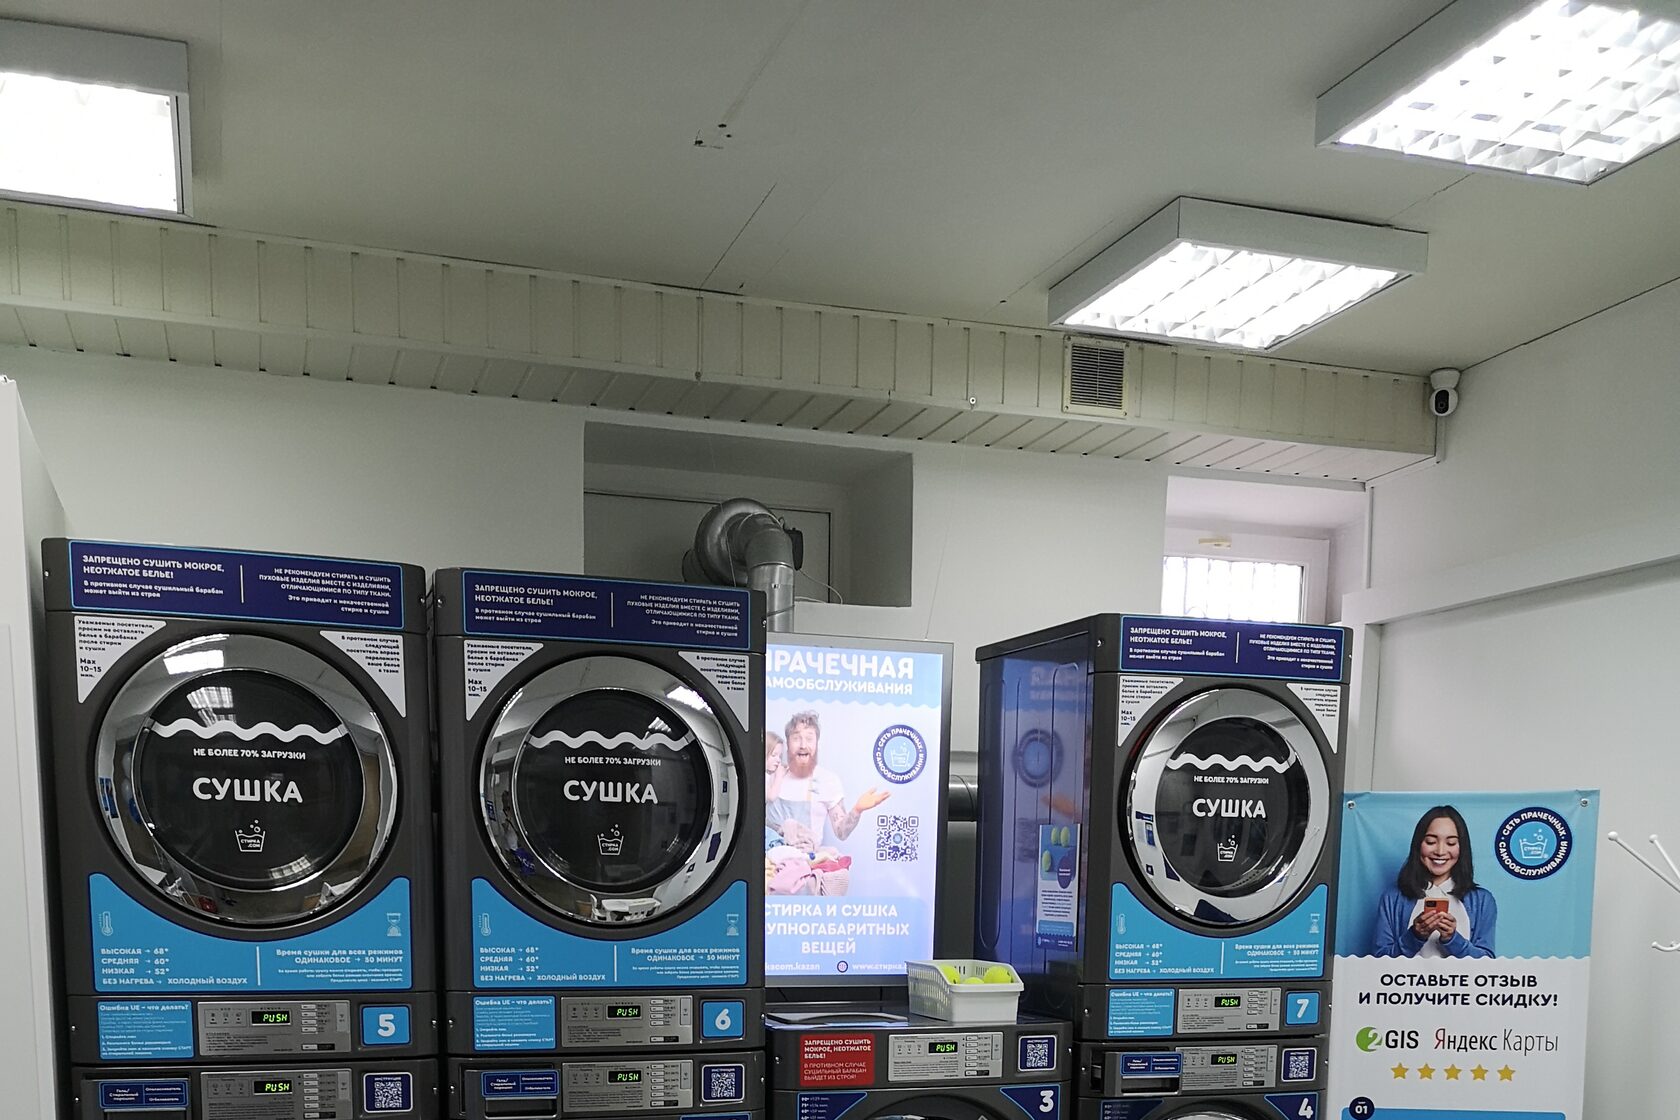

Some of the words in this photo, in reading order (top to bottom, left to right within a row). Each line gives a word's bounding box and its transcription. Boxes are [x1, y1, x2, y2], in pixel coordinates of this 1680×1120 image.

[83, 555, 140, 566] ЗАПРЕЩЕНО
[143, 559, 182, 568] СУШИТЬ
[184, 562, 224, 572] МОКРОЕ,
[84, 566, 140, 577] НЕОТЖАТОЕ
[143, 569, 173, 578] БЕЛЬЕ!
[475, 585, 524, 594] ЗАПРЕЩЕНО
[527, 588, 561, 596] СУШИТЬ
[563, 590, 597, 599] МОКРОЕ,
[475, 595, 524, 604] НЕОТЖАТОЕ
[527, 597, 553, 605] БЕЛЬЕ!
[766, 677, 912, 695] АМООБСЛУЖИВАНИЯ
[194, 748, 206, 757] НЕ
[208, 749, 238, 757] БОЛЕЕ
[241, 750, 259, 758] 70%
[261, 750, 306, 760] ЗАГРУЗКИ
[623, 758, 661, 766] ЗАГРУЗКИ
[193, 777, 303, 803] СУШКА
[563, 780, 658, 804] СУШКА
[1192, 798, 1266, 818] СУШКА
[1502, 816, 1521, 837] СЕТЬ
[1520, 810, 1566, 838] ПРАЧЕЧНЫХ
[1498, 840, 1569, 877] САМООБСЛУЖИВАНИЯ
[826, 904, 836, 917] И
[841, 904, 897, 917] СУШКА
[766, 923, 909, 935] УПНОГАБАРИТНЫХ
[101, 947, 142, 956] ВЫСОКАЯ
[801, 938, 856, 956] ВЕЩЕЙ
[1380, 973, 1469, 987] ОСТАВЬТЕ
[1474, 975, 1537, 988] ОТЗЫВ
[1221, 998, 1238, 1006] PUSH
[1359, 992, 1370, 1005] И
[1376, 992, 1470, 1006] ПОЛУЧИТЕ
[1475, 993, 1558, 1009] СКИДКУ!
[617, 1007, 638, 1017] PUSH
[1296, 999, 1309, 1018] 7
[263, 1014, 288, 1022] PUSH
[377, 1013, 395, 1037] 5
[715, 1008, 731, 1030] 6
[1360, 1029, 1419, 1051] 2GIS
[1434, 1028, 1497, 1052] Яндекс
[1503, 1028, 1559, 1056] Карты
[936, 1044, 955, 1052] PUSH
[1218, 1056, 1235, 1064] PUSH
[617, 1073, 639, 1081] PUSH
[265, 1083, 289, 1092] PUSH
[1039, 1090, 1054, 1113] 3
[1298, 1098, 1313, 1119] 4
[1355, 1105, 1368, 1114] 01
